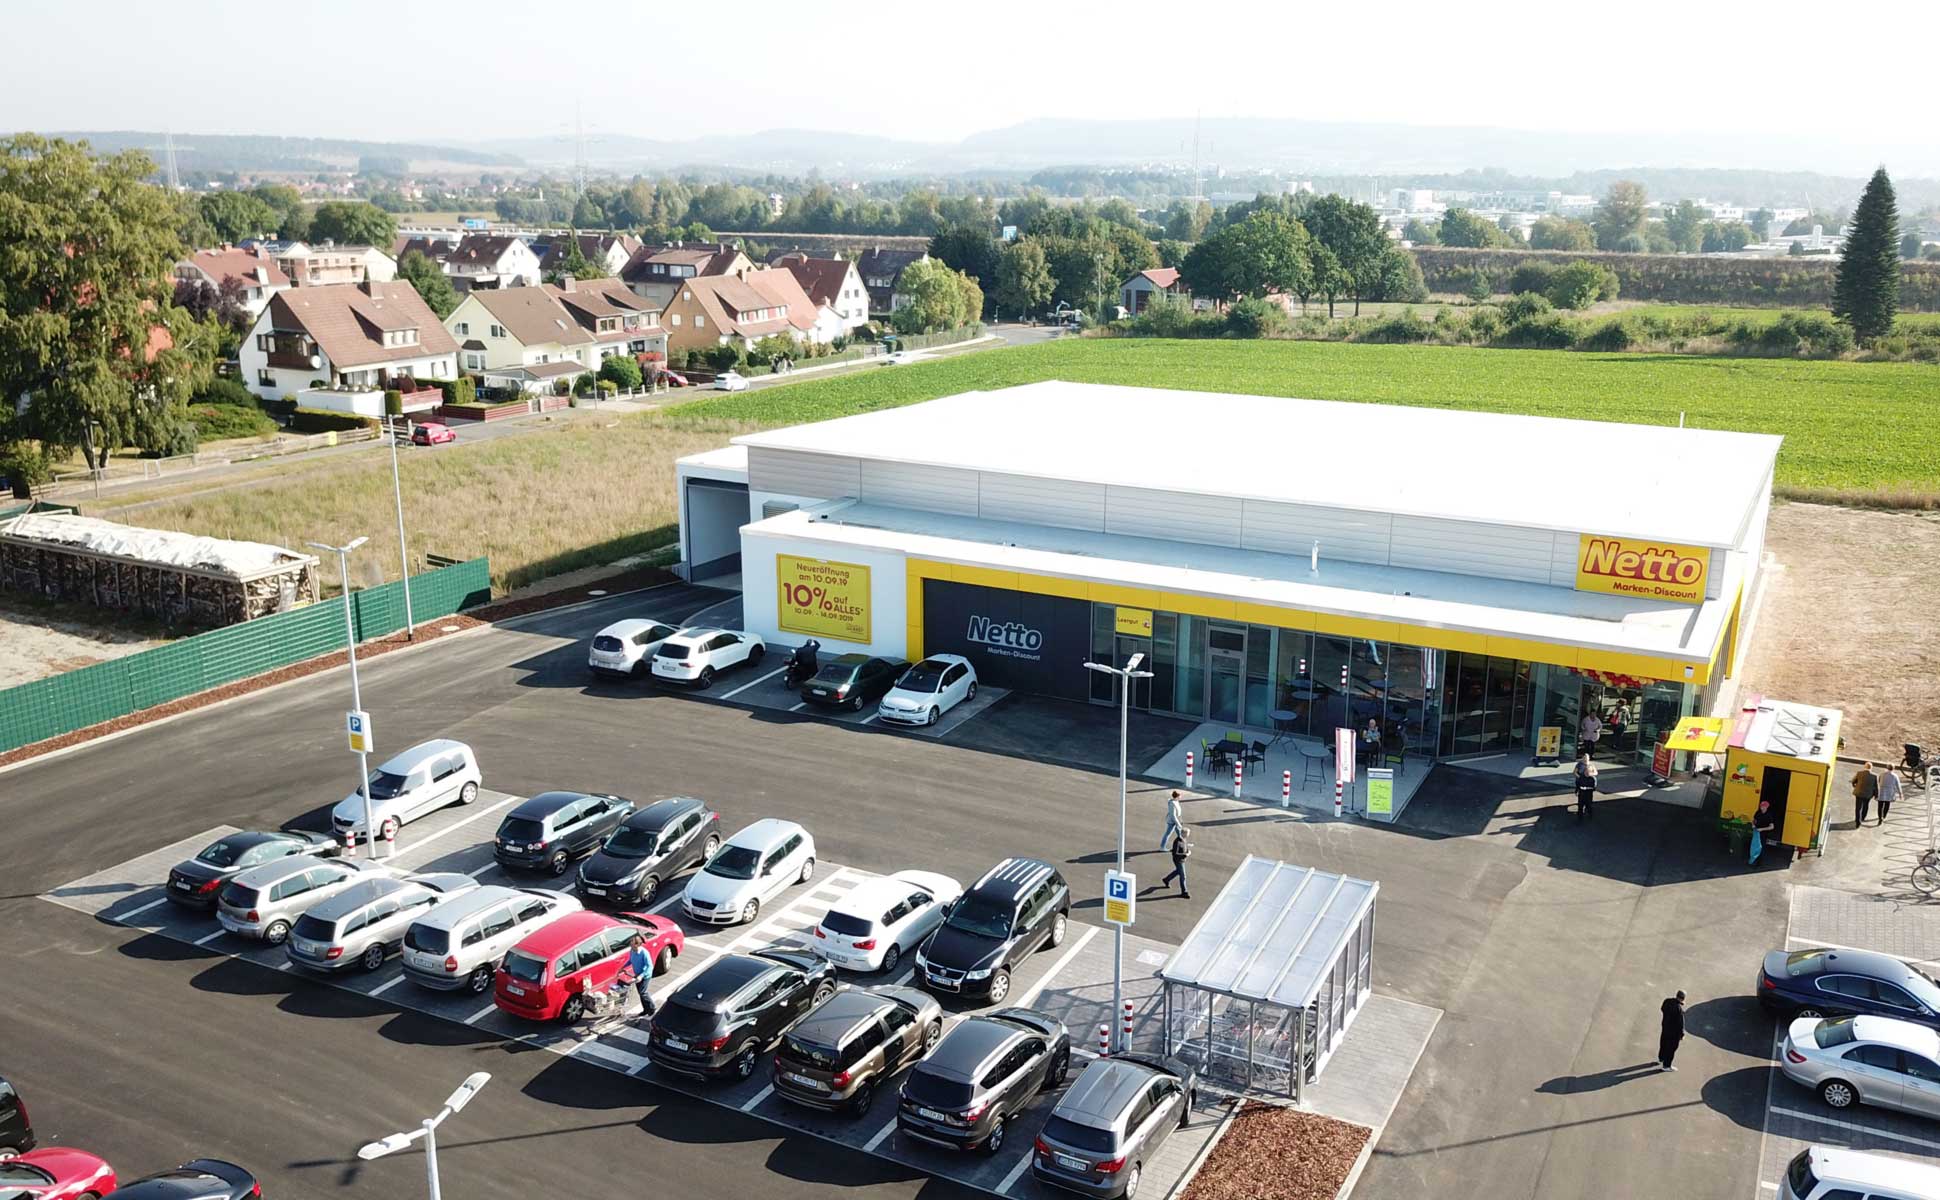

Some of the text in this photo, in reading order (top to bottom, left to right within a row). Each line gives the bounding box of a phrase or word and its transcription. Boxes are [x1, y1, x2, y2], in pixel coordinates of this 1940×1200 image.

[1583, 539, 1703, 585] Netto
[796, 563, 850, 578] Neueröffnung
[813, 574, 848, 586] 10.09.19
[783, 582, 833, 611] 10%
[1613, 582, 1697, 599] Marken-Discount
[833, 596, 848, 604] auf
[967, 615, 1043, 650] Netto
[987, 647, 1041, 661] Marken-Discount
[352, 718, 360, 730] P
[1112, 881, 1125, 896] P
